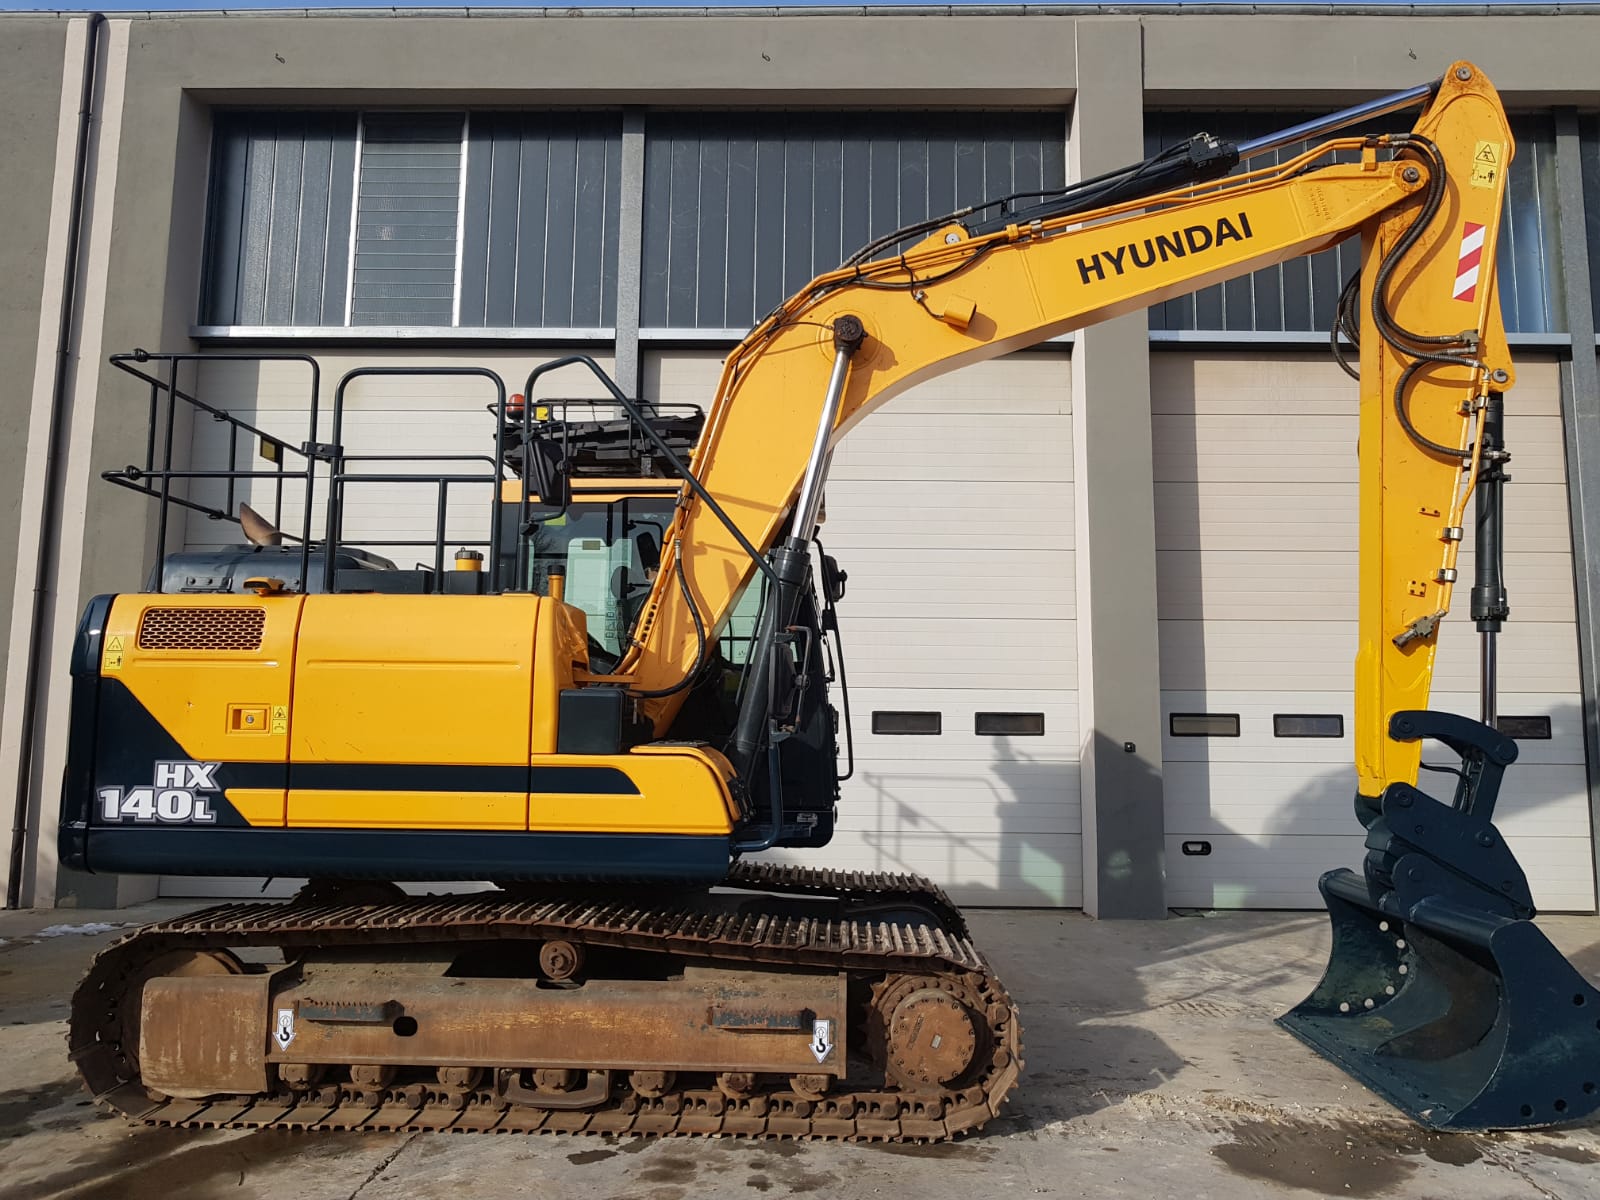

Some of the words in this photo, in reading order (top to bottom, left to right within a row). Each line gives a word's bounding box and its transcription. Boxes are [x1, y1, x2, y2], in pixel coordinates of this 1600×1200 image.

[1076, 212, 1253, 285] HYUNDAI
[155, 762, 220, 790] HX
[98, 787, 214, 821] 140L
